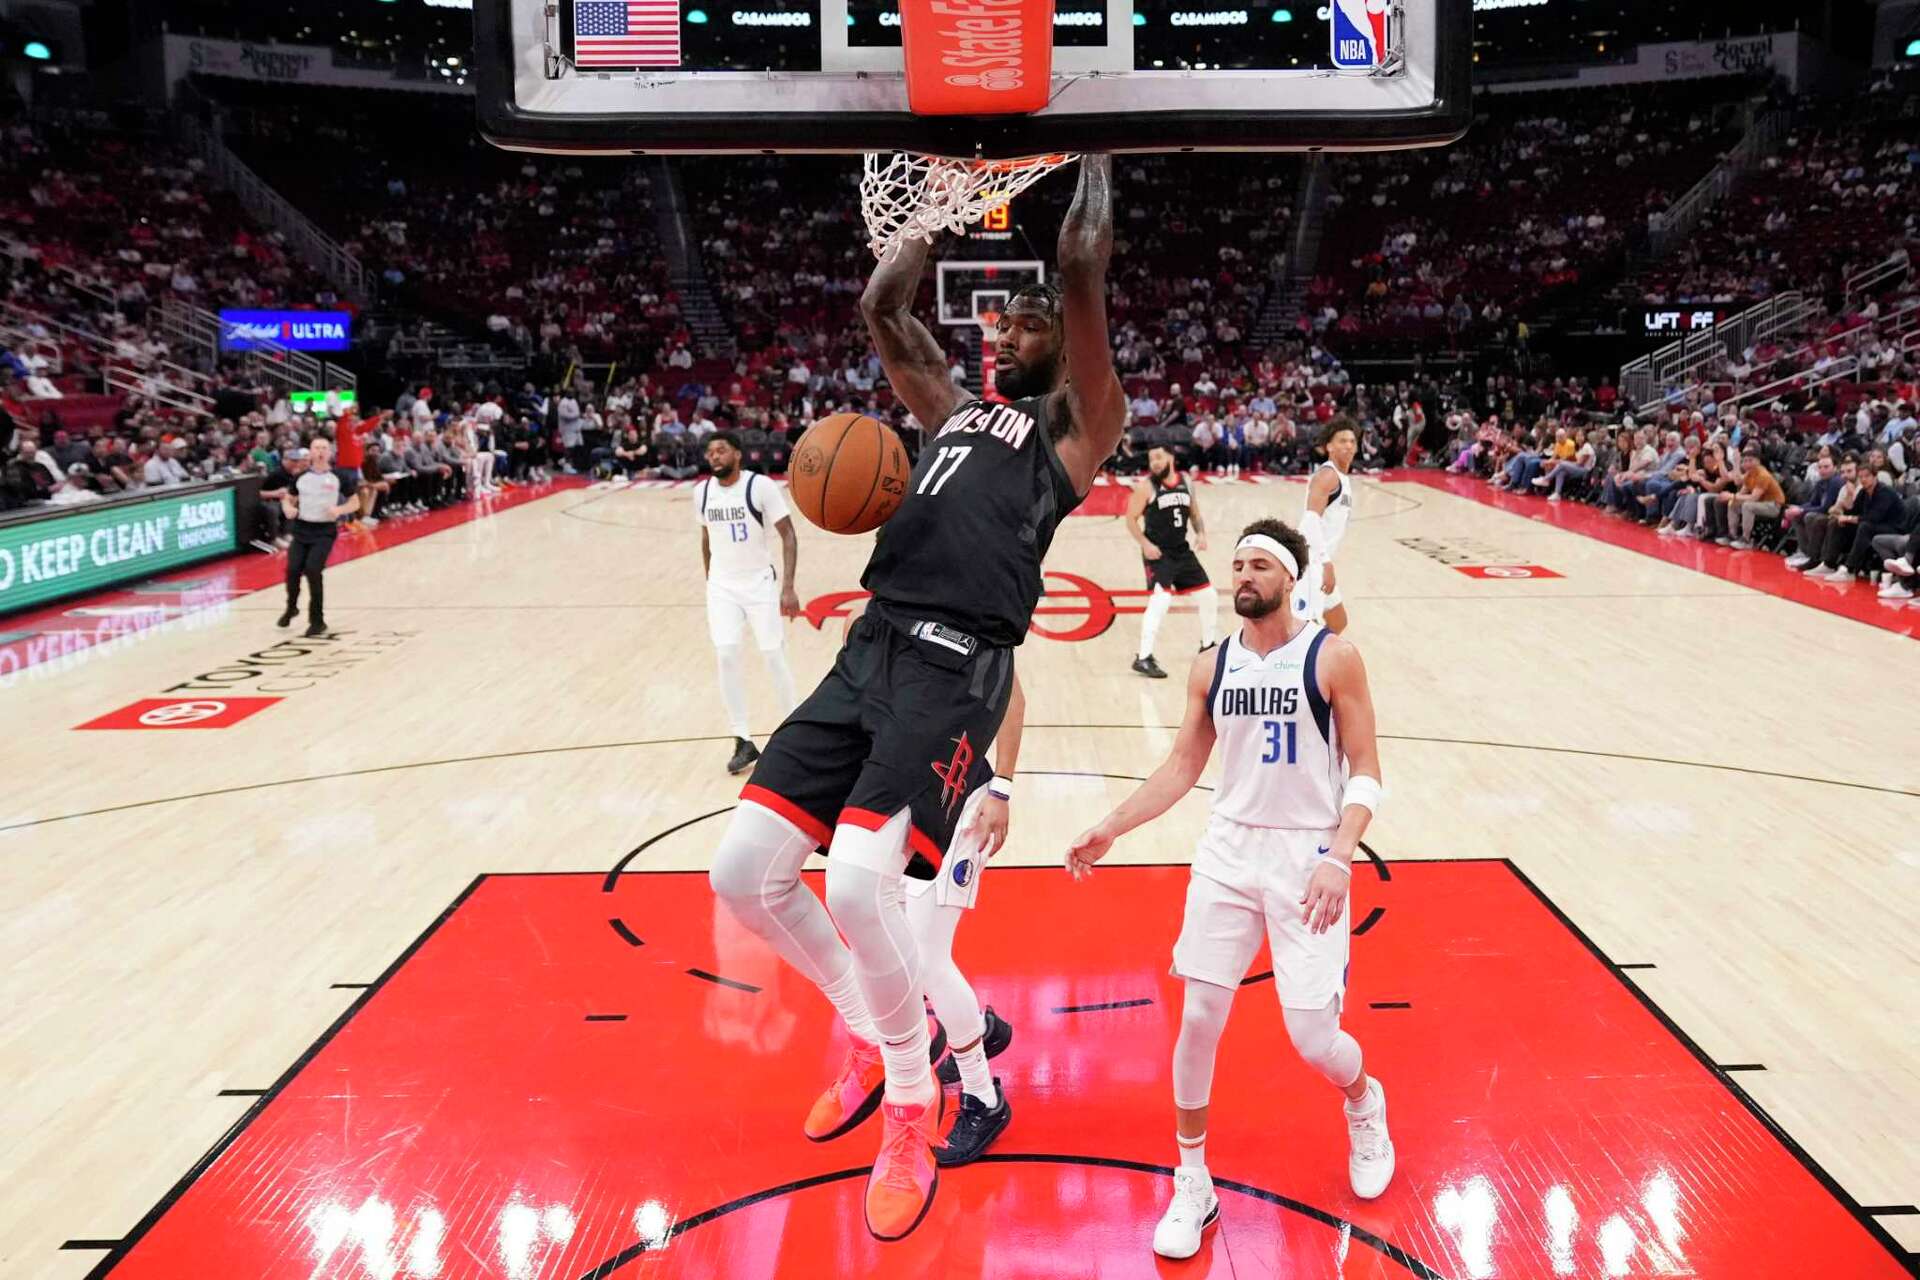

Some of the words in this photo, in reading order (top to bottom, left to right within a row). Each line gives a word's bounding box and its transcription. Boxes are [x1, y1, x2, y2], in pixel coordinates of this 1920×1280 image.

[731, 11, 811, 26] CASAMIGOS
[1170, 10, 1249, 26] CASAMIGOS
[1339, 39, 1367, 60] NBA
[292, 322, 345, 339] ULTRA
[933, 403, 1035, 450] OUSTON
[916, 445, 973, 496] 17
[707, 506, 746, 523] DALLAS
[1172, 507, 1183, 528] 5
[729, 521, 749, 543] 13
[21, 533, 87, 585] KEEP
[1221, 686, 1299, 717] DALLAS
[1261, 720, 1298, 765] 31
